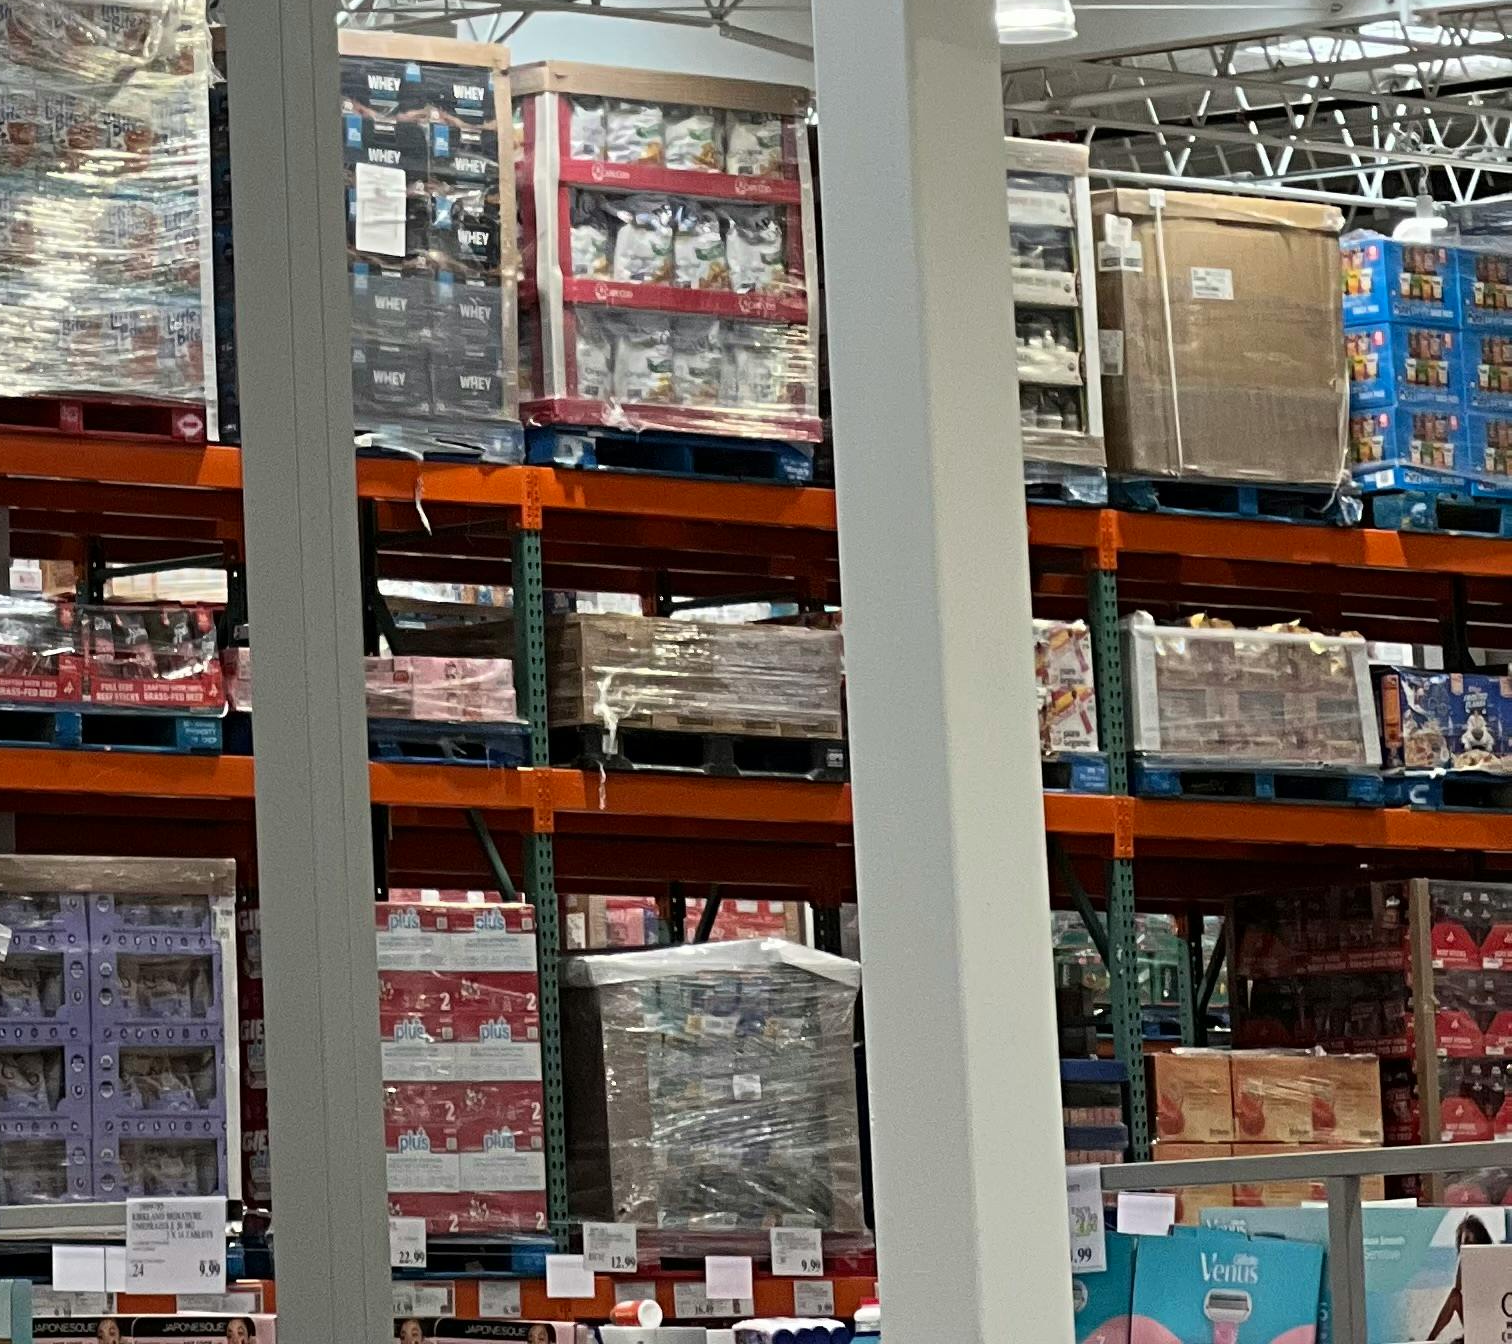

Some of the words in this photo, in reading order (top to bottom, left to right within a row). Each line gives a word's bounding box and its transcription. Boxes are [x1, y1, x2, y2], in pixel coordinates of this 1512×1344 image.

[368, 75, 401, 92] WHEY
[453, 84, 484, 101] WHEY
[368, 148, 401, 164] WHEY
[455, 158, 487, 174] WHEY
[458, 229, 488, 245] WHEY
[375, 296, 408, 311] WHEY
[460, 303, 491, 320] WHEY
[373, 370, 406, 386] WHEY
[460, 375, 491, 391] WHEY
[440, 993, 451, 1011] 2
[526, 993, 537, 1011] 2
[395, 1020, 425, 1040] plus
[480, 1020, 511, 1041] plus
[445, 1103, 455, 1121] 2
[531, 1102, 541, 1120] 2
[400, 1133, 429, 1152] plus
[485, 1133, 514, 1151] plus
[449, 1215, 458, 1232] 2
[535, 1212, 545, 1229] 2
[400, 1250, 425, 1264] 22.99
[611, 1256, 636, 1269] 12.99
[801, 1259, 821, 1272] 9.99
[199, 1263, 221, 1277] 9.99
[1201, 1252, 1258, 1283] Venus
[33, 1322, 96, 1333] JAPONESQUE
[163, 1322, 225, 1332] JAPONESQUE
[465, 1325, 529, 1337] JAPONESQUE
